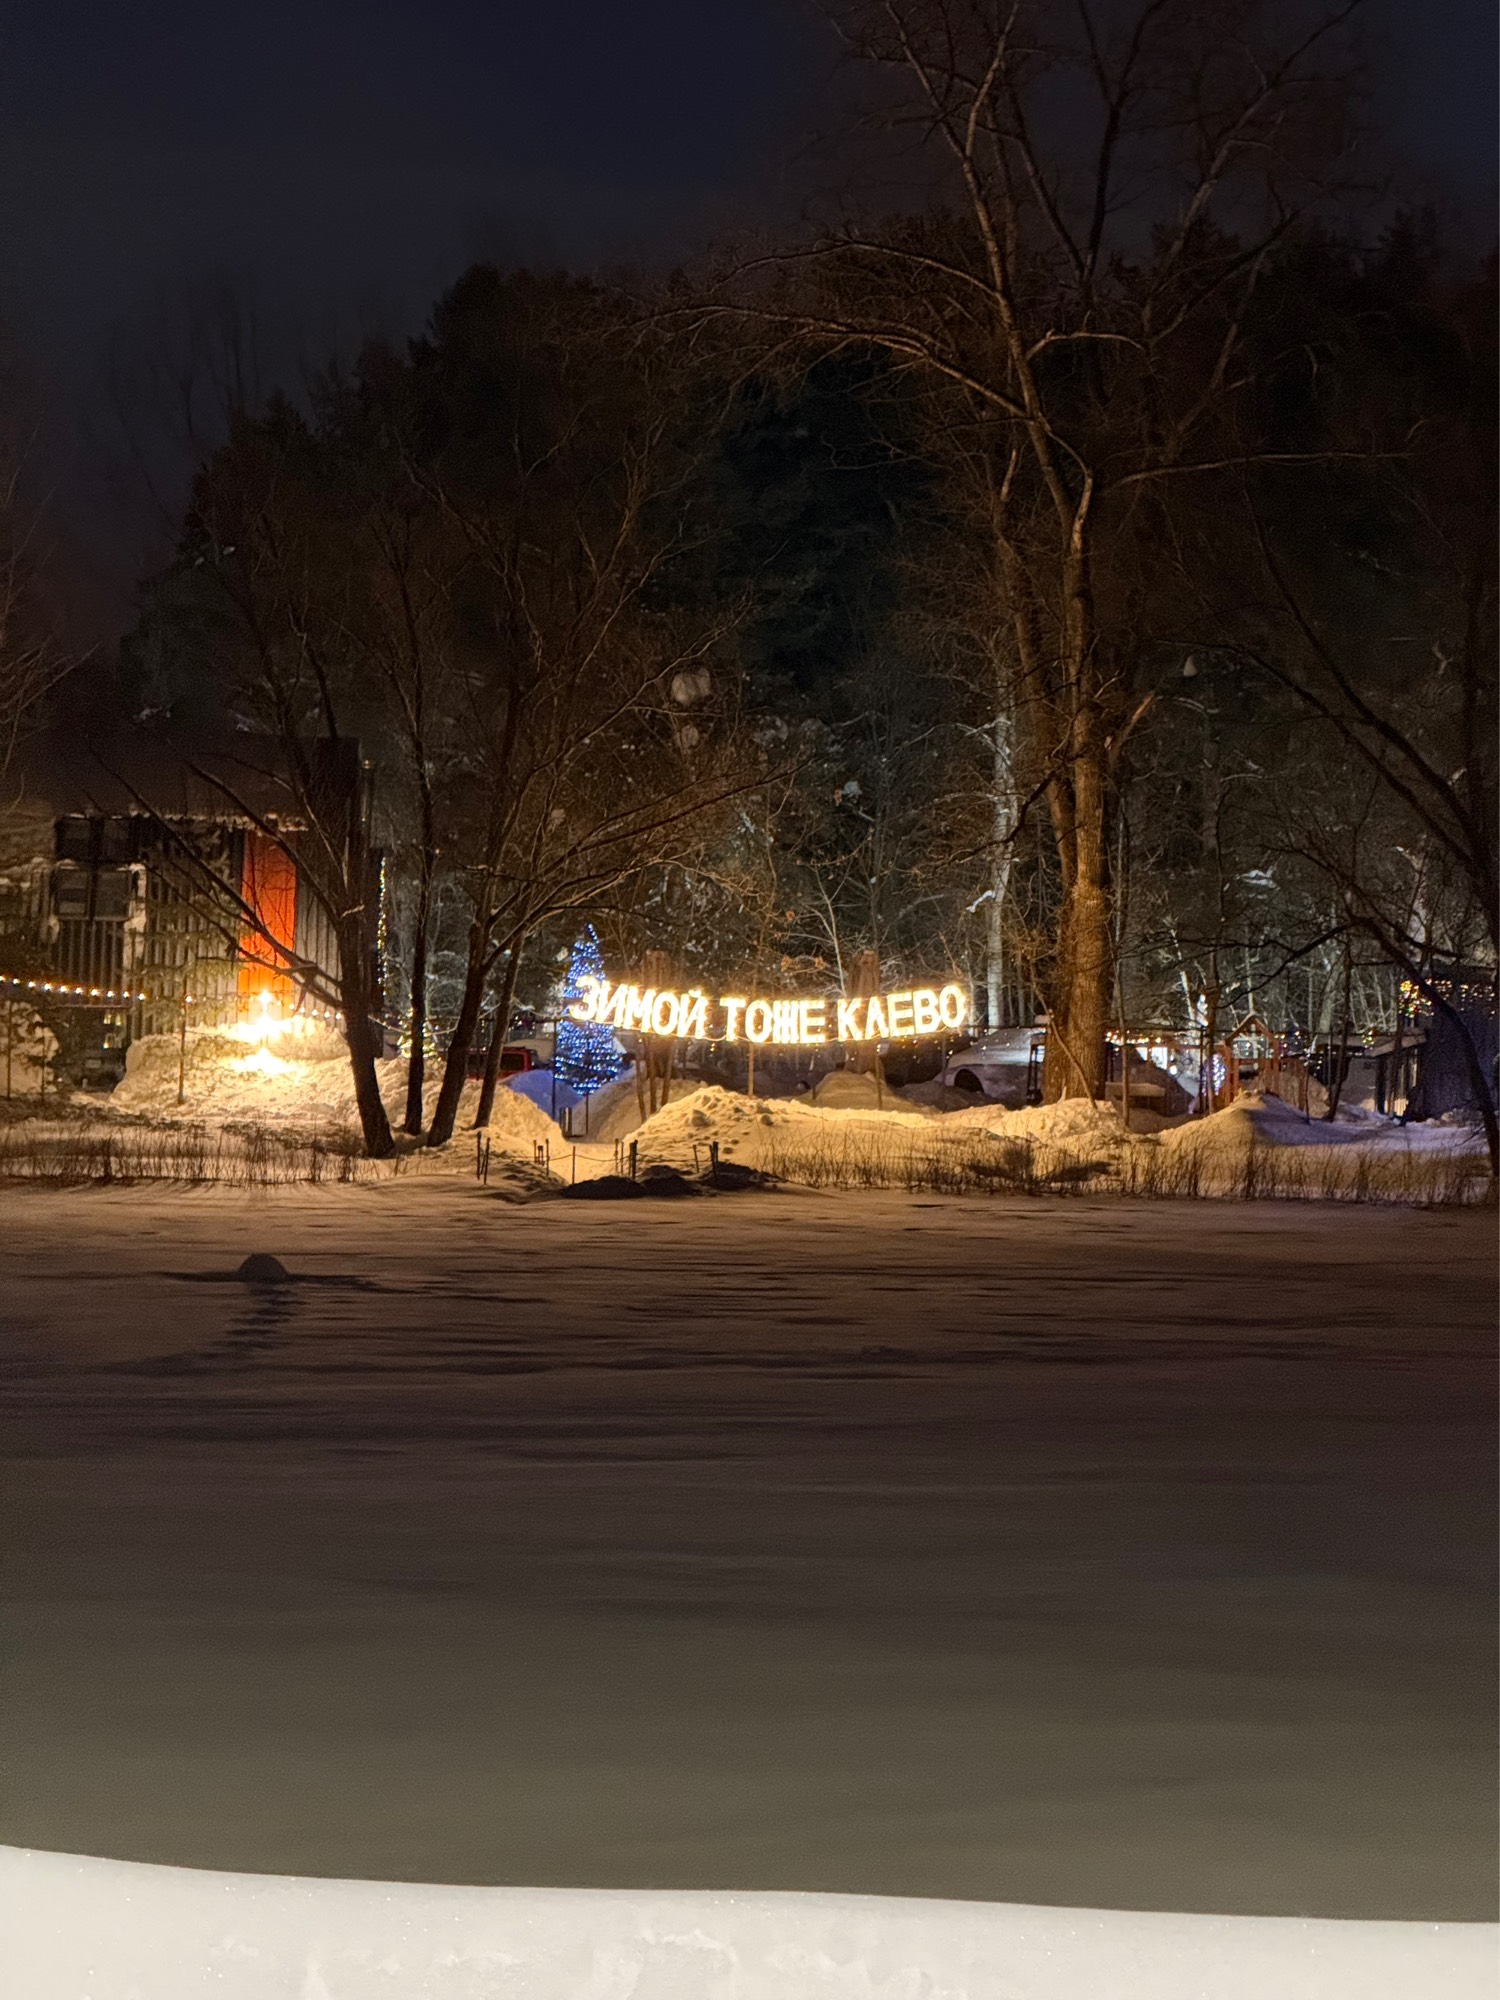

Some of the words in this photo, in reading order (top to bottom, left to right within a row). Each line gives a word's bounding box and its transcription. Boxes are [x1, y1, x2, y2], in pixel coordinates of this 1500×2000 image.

[570, 976, 706, 1039] ЗИМОЙ
[720, 997, 826, 1043] ТОЖЕ
[837, 984, 968, 1041] КЛЕВО
